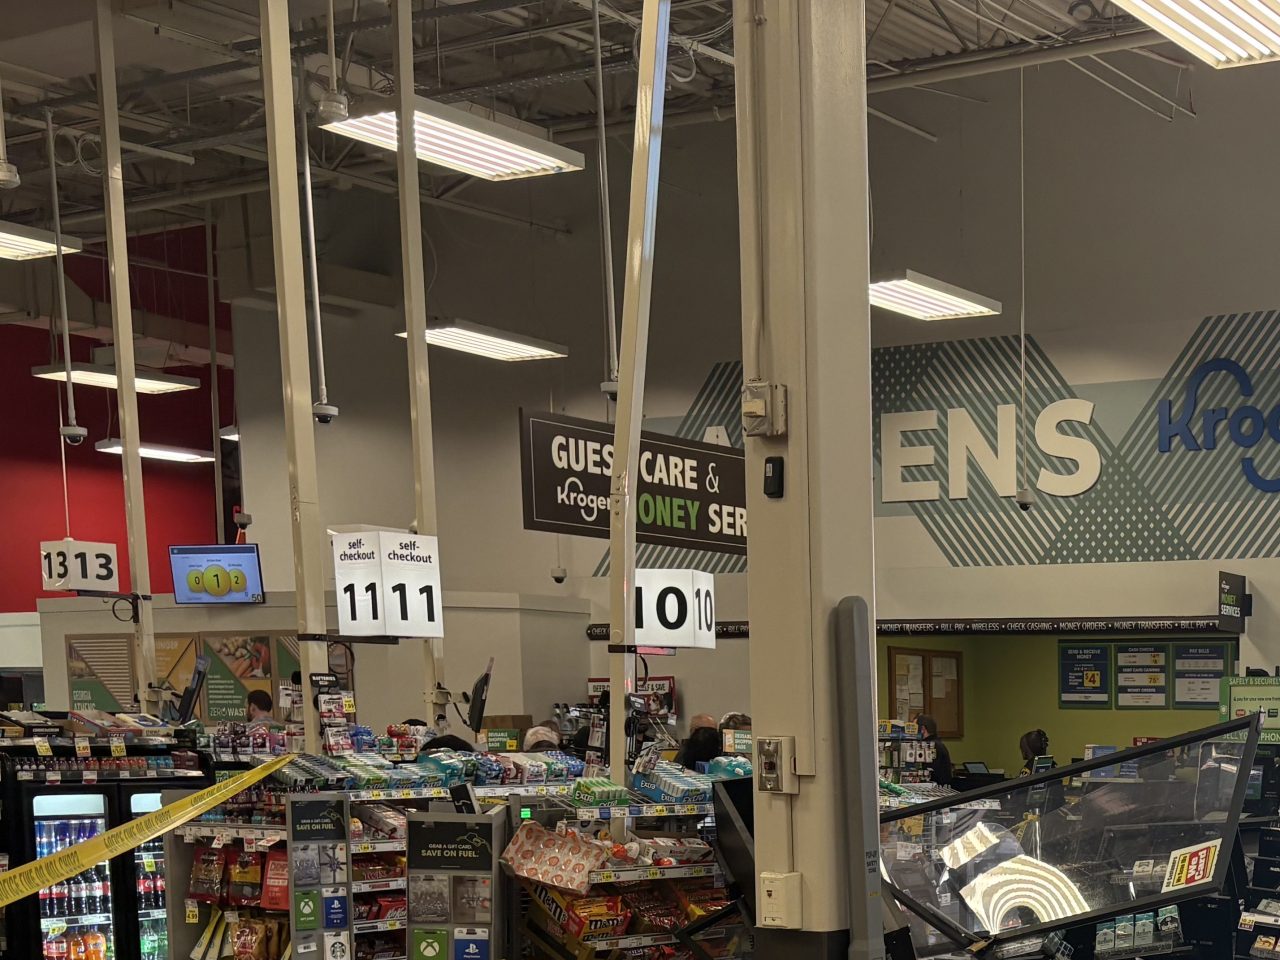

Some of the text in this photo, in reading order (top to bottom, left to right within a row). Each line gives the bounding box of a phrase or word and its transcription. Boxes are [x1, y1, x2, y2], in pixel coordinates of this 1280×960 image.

[881, 399, 1102, 504] ENS
[551, 435, 720, 494] GUES CARE &
[637, 493, 747, 537] ONEY SER
[348, 538, 365, 550] self-
[399, 541, 420, 551] self-
[339, 550, 375, 562] checkout
[388, 551, 432, 564] checkout
[43, 550, 68, 580] 13
[74, 552, 114, 581] 13
[213, 573, 220, 589] 1
[343, 582, 379, 621] 11
[391, 583, 435, 622] 11
[695, 588, 713, 632] 10
[1221, 605, 1240, 617] SERVICES
[882, 624, 901, 632] MONEY
[903, 624, 934, 632] TRANSFERS
[954, 623, 964, 631] PAY
[971, 623, 999, 631] WIRELESS
[1007, 623, 1025, 631] CHECK
[1026, 622, 1052, 631] CASHING
[1060, 622, 1080, 630] MONEY
[1081, 622, 1106, 630] ORDERS
[1114, 622, 1135, 630] MONEY
[1137, 621, 1173, 630] TRANSFERS
[1180, 621, 1195, 629] BILL
[1196, 621, 1207, 629] PAY
[1229, 677, 1248, 685] SAFELY
[73, 690, 91, 700] GEORGIA
[228, 708, 247, 717] WAST
[575, 791, 594, 802] Extra
[1187, 856, 1198, 879] We
[1194, 849, 1207, 880] Card
